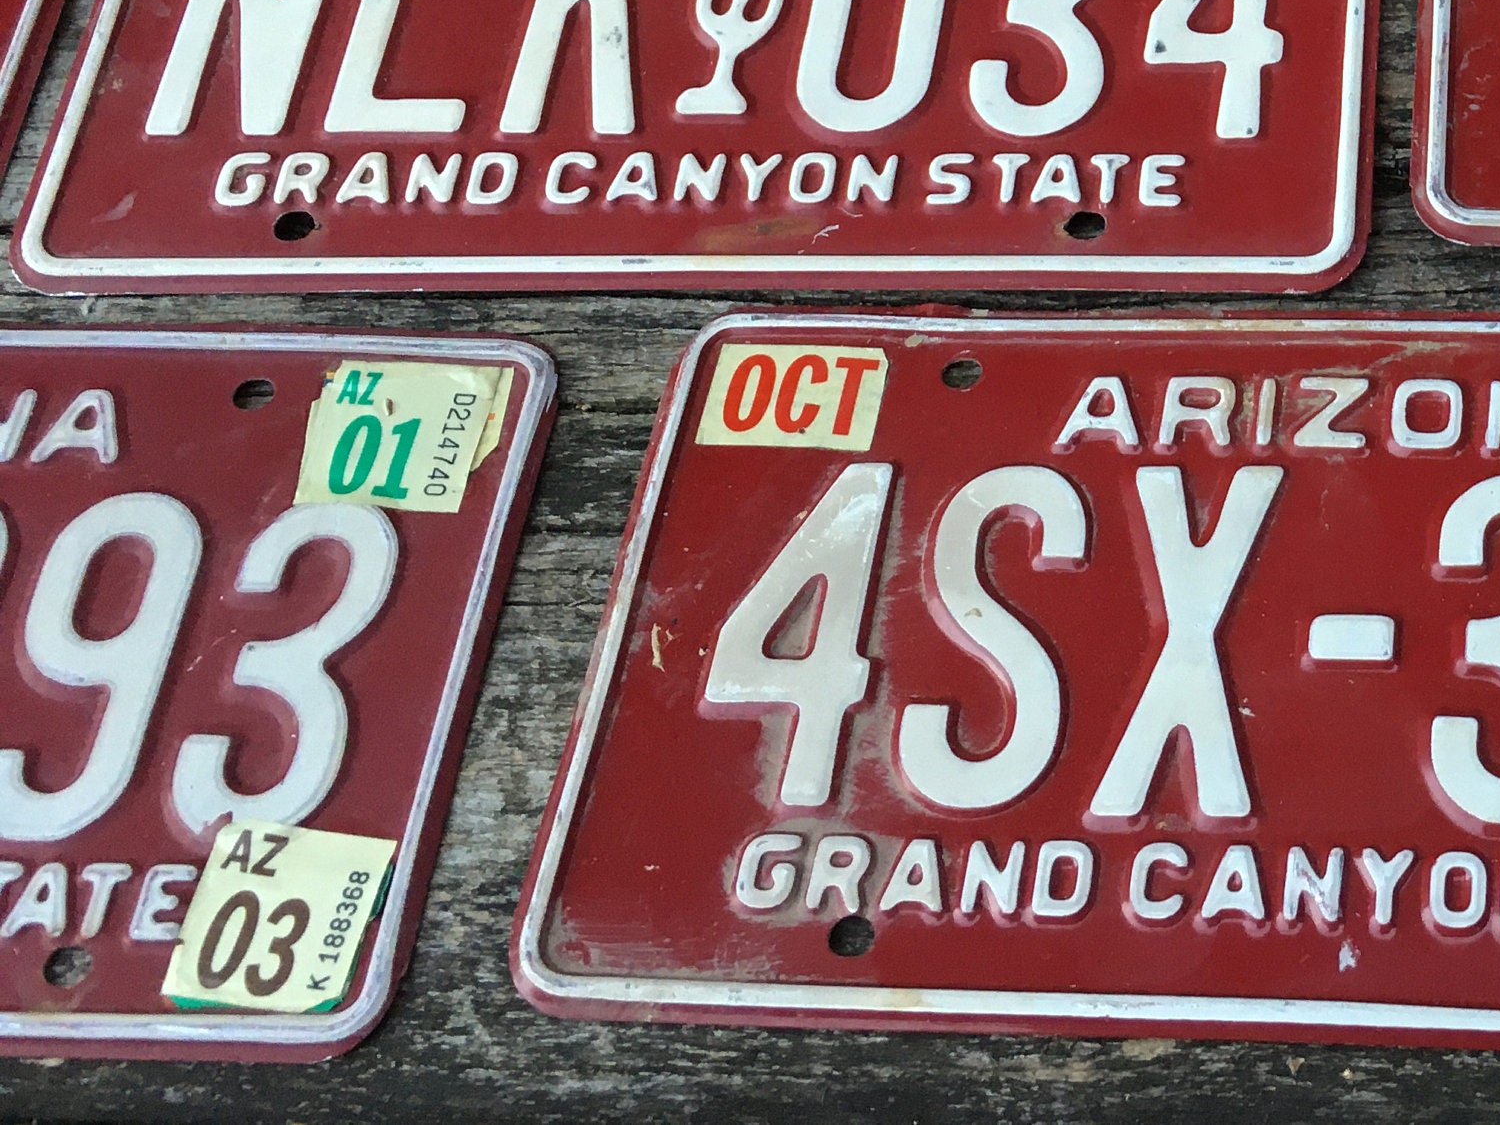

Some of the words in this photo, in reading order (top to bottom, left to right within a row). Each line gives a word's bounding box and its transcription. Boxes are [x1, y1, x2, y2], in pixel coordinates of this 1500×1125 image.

[214, 152, 519, 207] GRAND
[544, 152, 898, 206] CANYON
[926, 153, 1187, 207] STATE
[336, 370, 383, 406] AZ
[722, 353, 880, 436] OCT
[328, 414, 421, 500] 01
[424, 393, 477, 497] D214740
[0, 491, 400, 843] 93
[220, 829, 290, 877] AZ
[735, 833, 1094, 919] GRAND
[197, 890, 311, 997] 03
[318, 870, 370, 964] 188368
